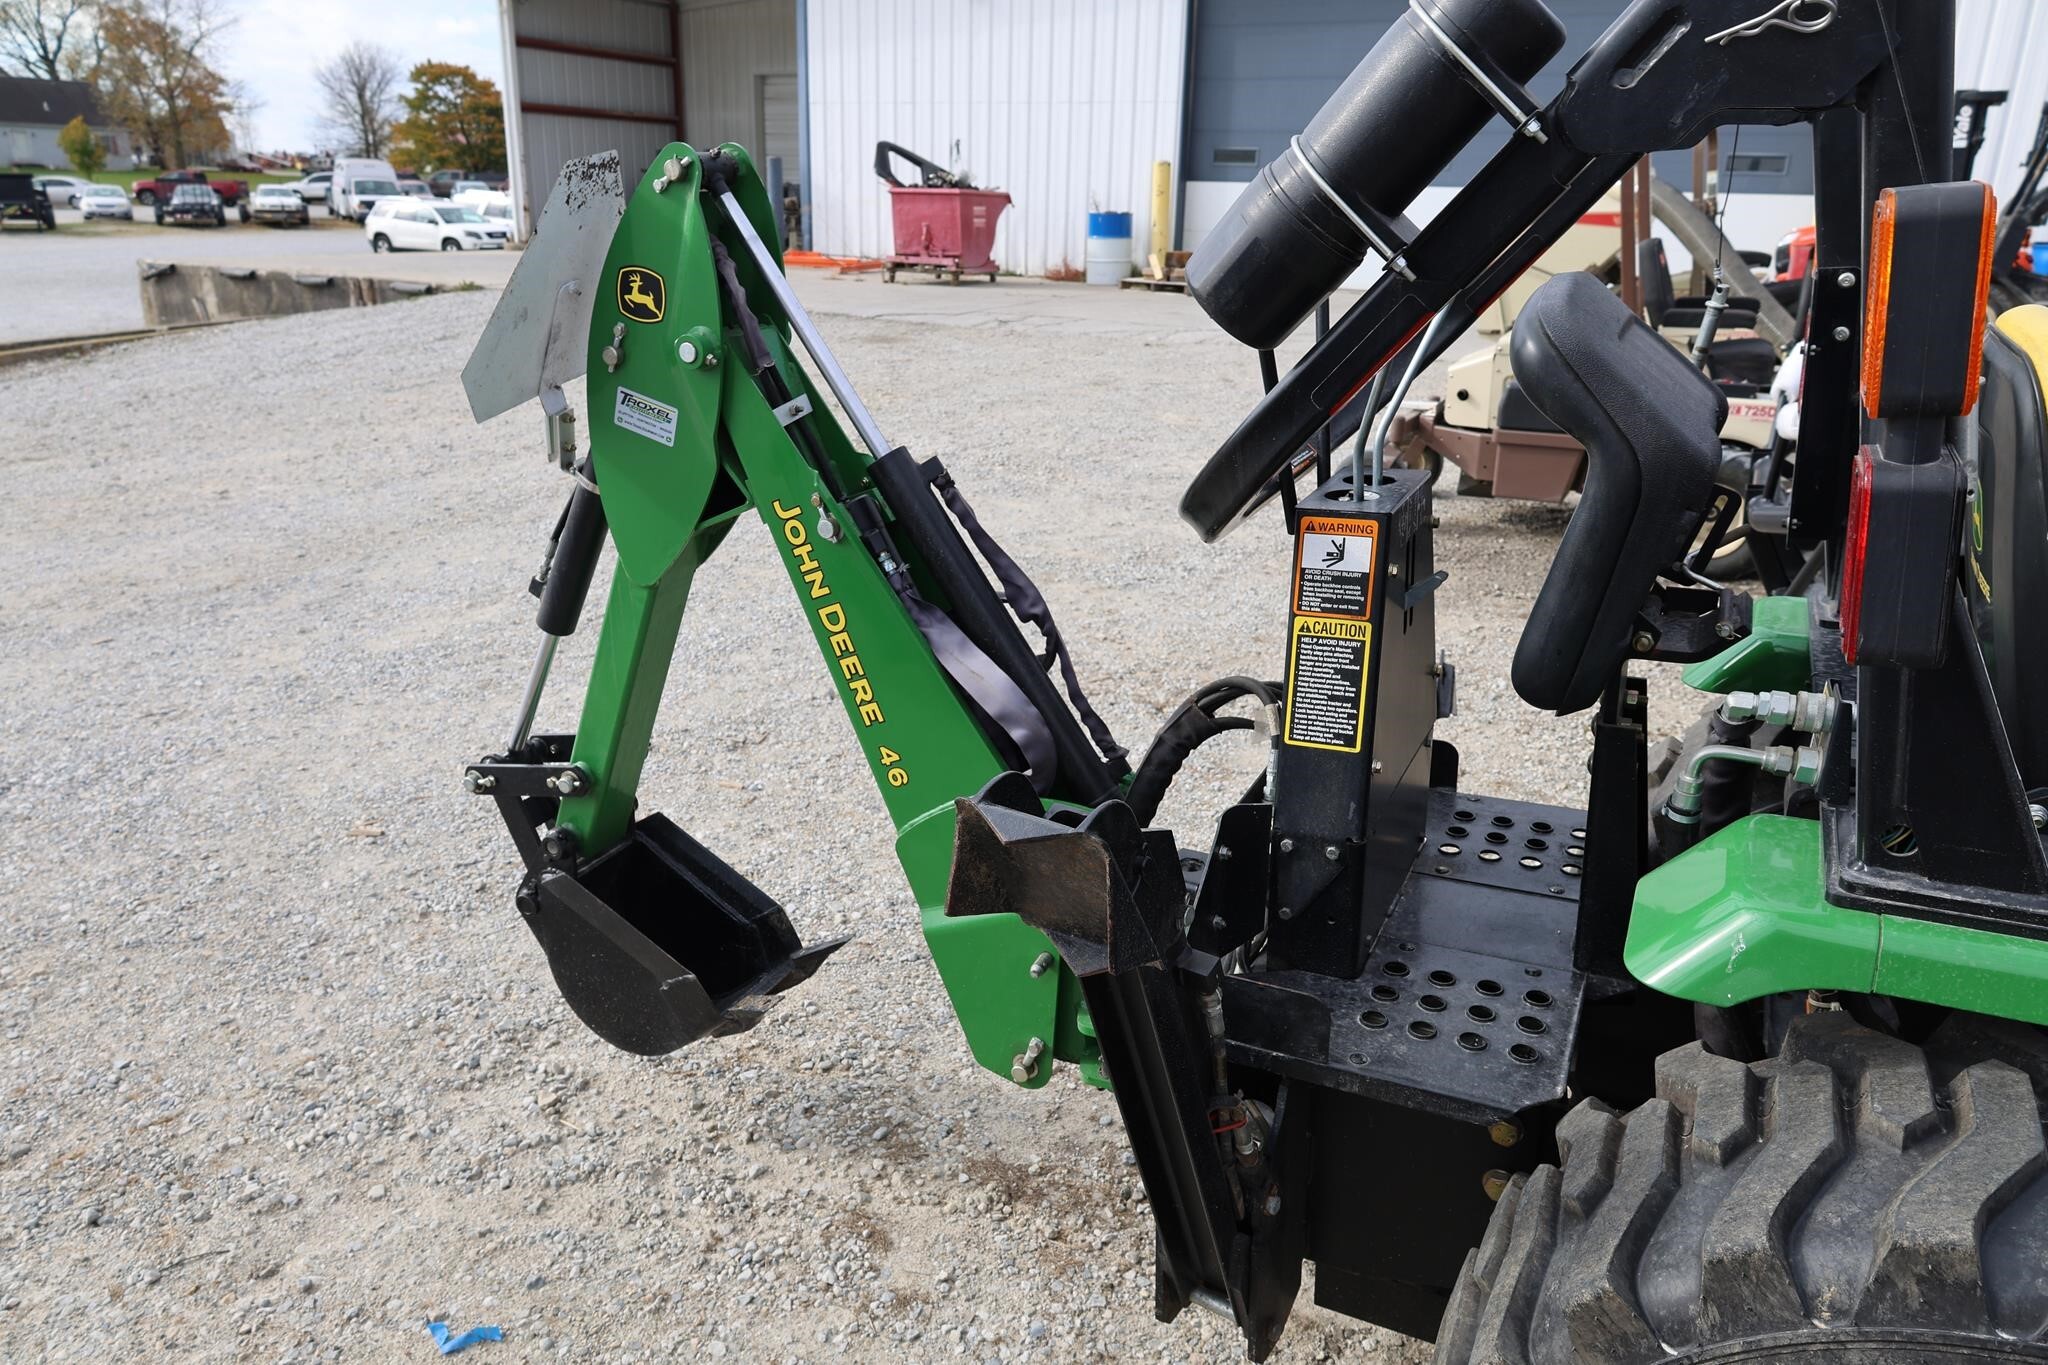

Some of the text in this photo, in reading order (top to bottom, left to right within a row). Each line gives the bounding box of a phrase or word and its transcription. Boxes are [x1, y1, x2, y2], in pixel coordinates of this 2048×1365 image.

[620, 390, 672, 420] TROXEL
[1318, 522, 1374, 534] WARNING
[1313, 621, 1366, 638] CAUTION
[772, 499, 909, 788] JOHN DEERE 46
